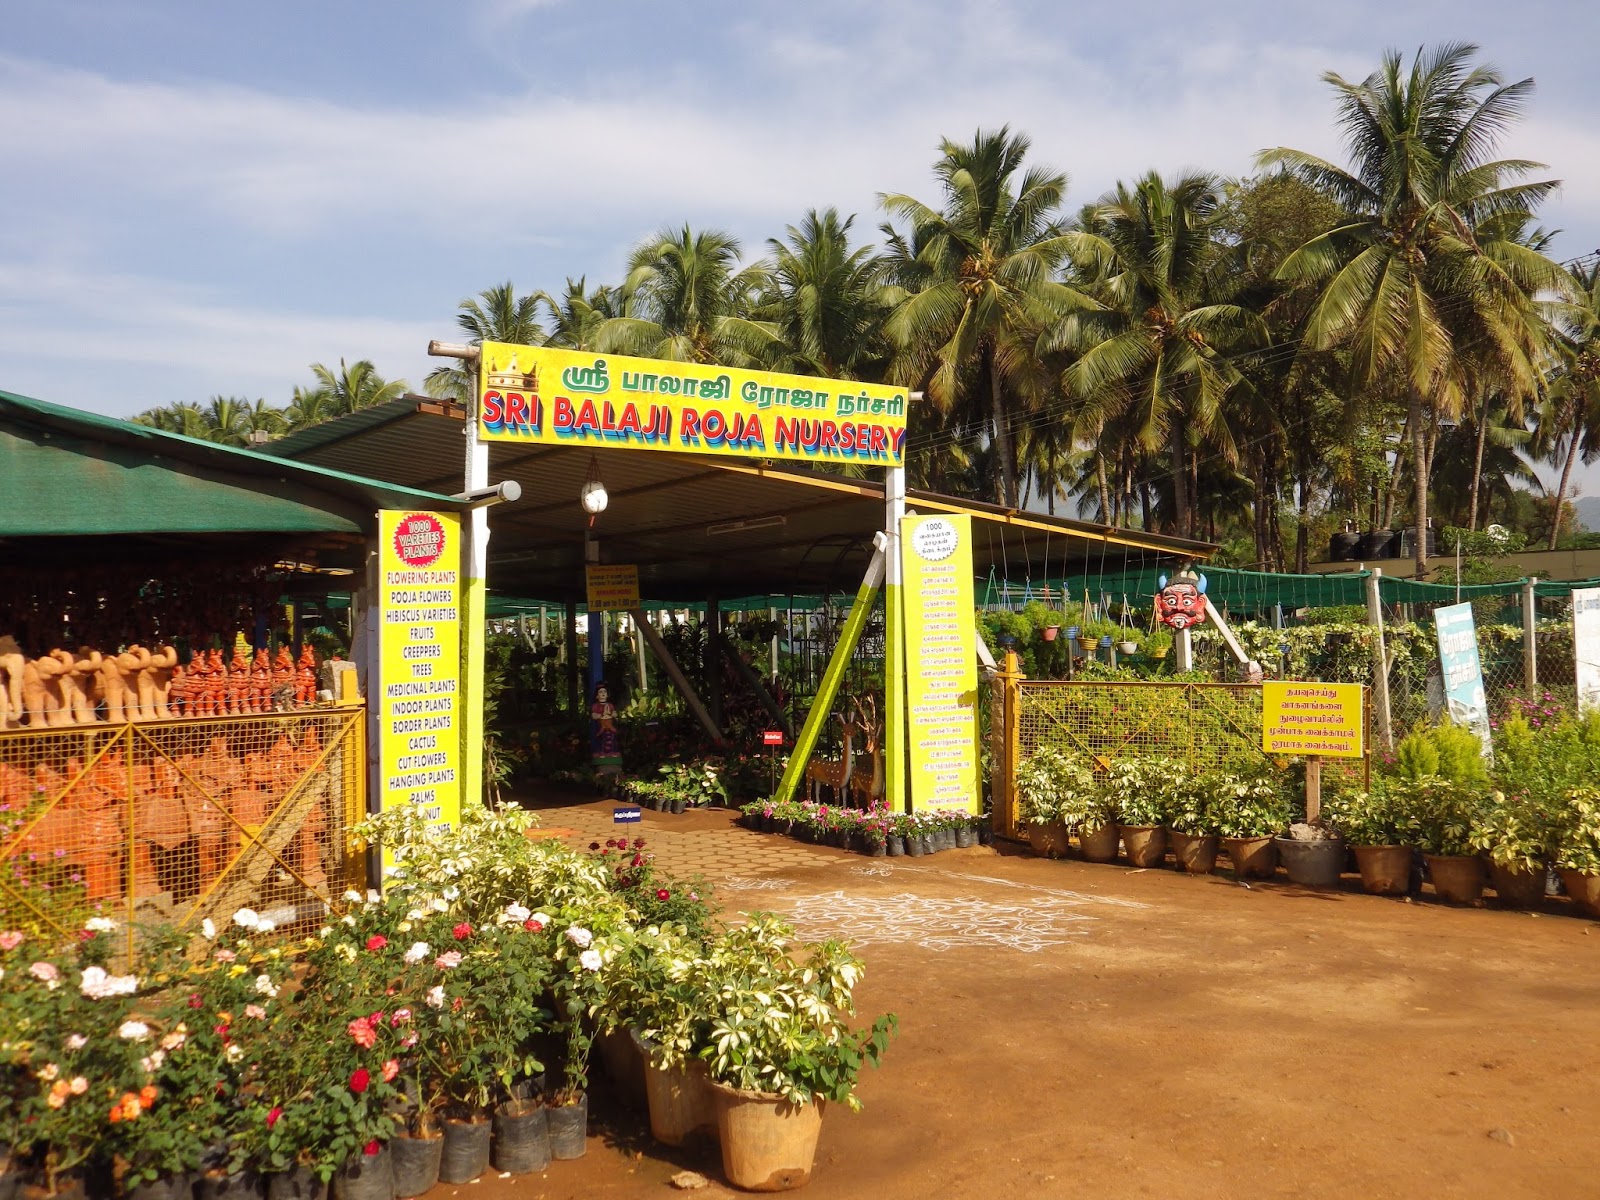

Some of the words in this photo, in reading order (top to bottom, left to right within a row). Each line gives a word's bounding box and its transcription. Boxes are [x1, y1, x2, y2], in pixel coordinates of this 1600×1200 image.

[562, 359, 610, 393] ஸ்ரீ
[622, 372, 731, 400] பாலாஜி
[741, 381, 829, 409] ரோஜா
[836, 391, 905, 417] நர்சரி
[482, 391, 543, 437] SRI
[553, 397, 672, 446] BALAJI
[680, 407, 766, 453] ROJA
[774, 416, 906, 462] NURSERY
[408, 520, 431, 533] 1000
[926, 522, 943, 531] 1000
[399, 532, 440, 547] VARETIES
[404, 544, 438, 558] PLANTS
[387, 571, 428, 585] FLOWERING
[430, 571, 456, 584] PLANTS
[391, 591, 417, 604] POOJA
[419, 590, 452, 603] FLOWERS
[386, 609, 421, 623] HIBISCUS
[423, 608, 456, 621] VARIETIES
[410, 627, 434, 640] FRUITS
[403, 645, 441, 659] CREEPPERS
[412, 664, 432, 676] TREES
[387, 681, 427, 697] MEDICINAL
[429, 679, 456, 693] PLANTS
[1286, 687, 1337, 699] தயவுசெய்து
[392, 701, 423, 715] INDOOR
[425, 698, 452, 712] PLANTS
[393, 720, 422, 733] BORDER
[424, 716, 451, 730] PLANTS
[409, 736, 436, 750] CACTUS
[398, 757, 412, 769] CUT
[414, 753, 446, 768] FLOWERS
[389, 775, 426, 790] HANGING
[428, 769, 454, 785] PLANTS
[411, 790, 435, 804] PALMS
